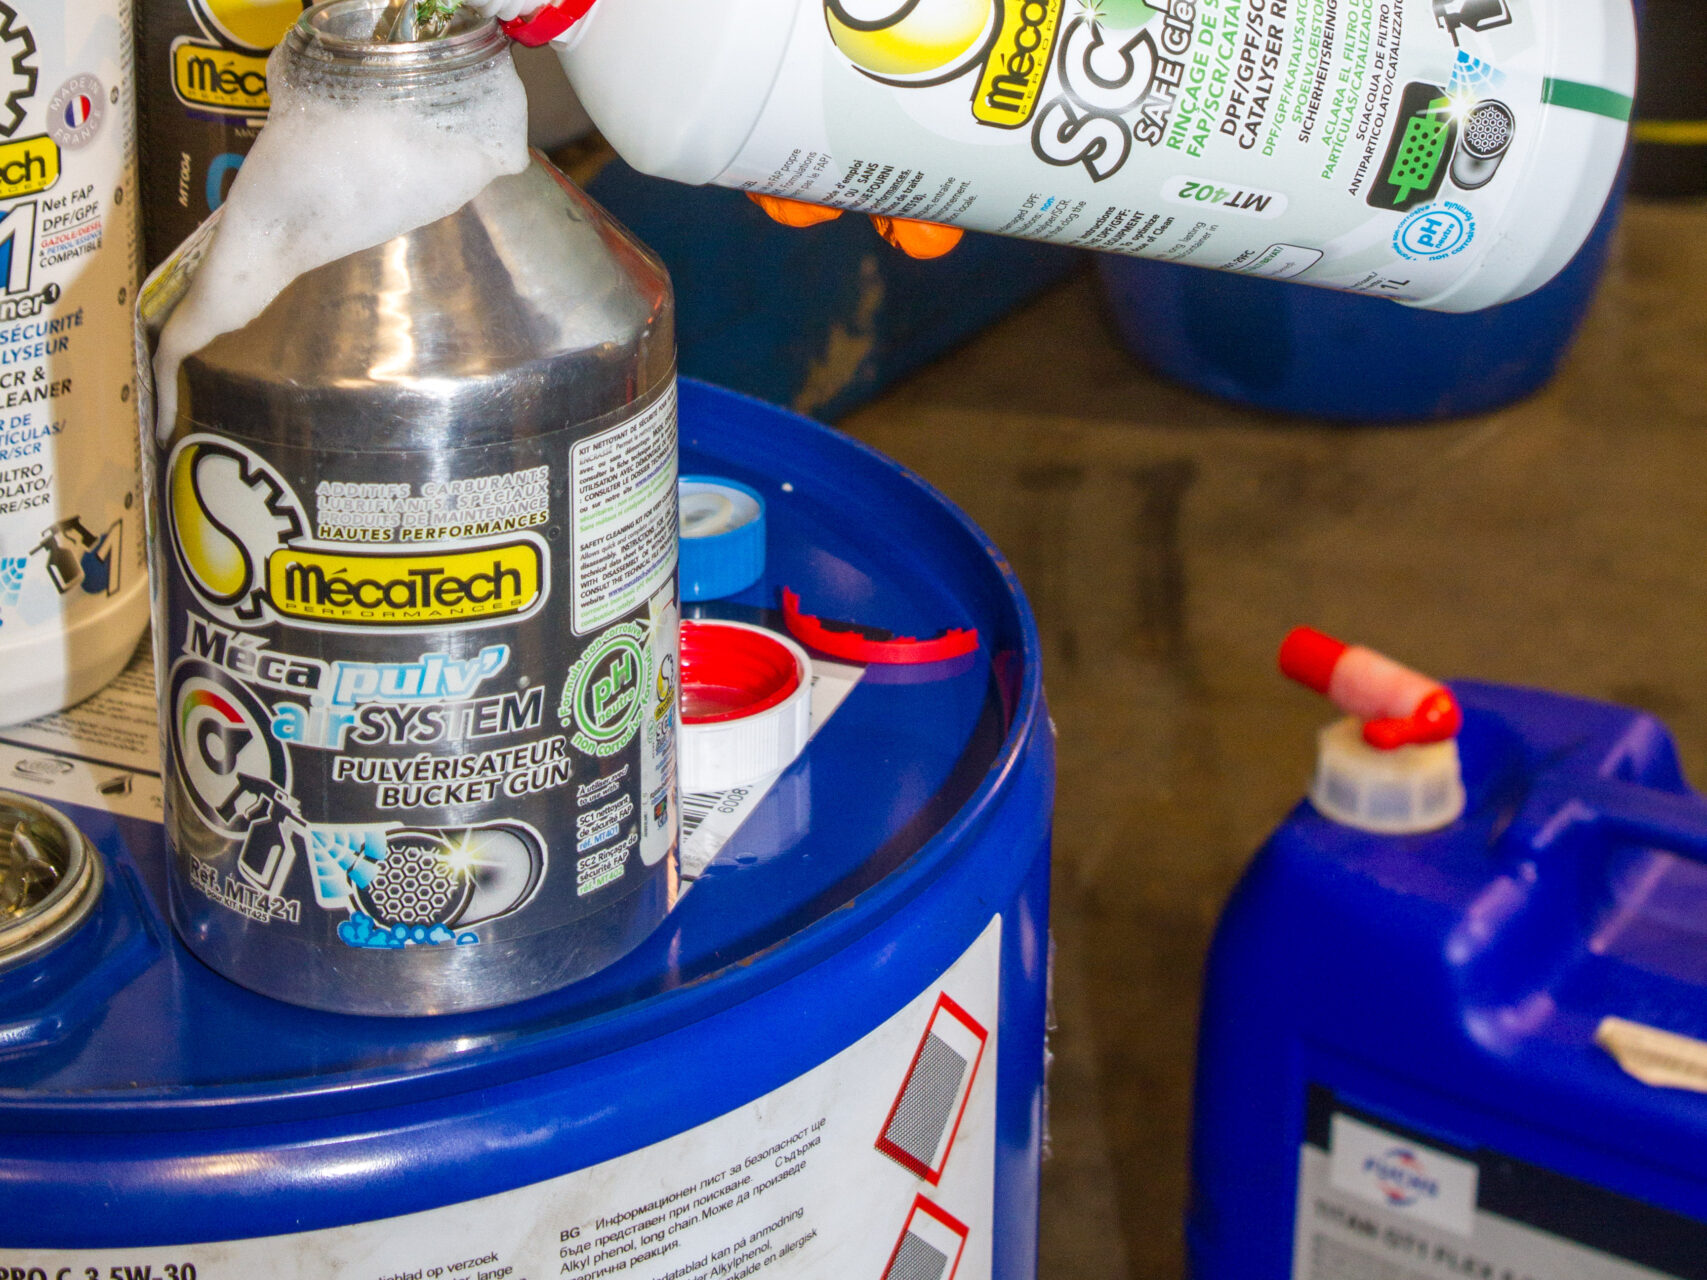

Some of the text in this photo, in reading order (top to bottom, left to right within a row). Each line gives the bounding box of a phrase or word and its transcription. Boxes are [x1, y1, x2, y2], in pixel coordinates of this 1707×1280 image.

[1343, 10, 1360, 61] FILTRO
[1166, 51, 1210, 150] RINÇAGE
[1198, 13, 1218, 47] DE
[1238, 24, 1284, 150] CATALYSER
[1338, 66, 1351, 83] EL
[1356, 3, 1390, 141] SCIACQUA DE FILTRO
[51, 76, 86, 111] MADE
[88, 78, 99, 96] IN
[1134, 56, 1186, 147] SAFE
[1321, 86, 1346, 147] ACLARA
[179, 151, 191, 208] MT004
[857, 162, 879, 184] SANS
[42, 197, 68, 213] Net
[70, 184, 94, 205] FAP
[1179, 180, 1273, 212] MT402
[42, 201, 100, 232] DPF/GPF
[1417, 217, 1443, 248] pH
[1435, 223, 1455, 249] neutre
[39, 237, 103, 269] COMPATIBLE
[33, 366, 45, 381] &
[10, 413, 31, 428] DE
[318, 467, 548, 498] ADDITIFS CARBURANTS
[319, 483, 548, 512] LUBRIFIANTS SPÉCIAUX
[579, 473, 618, 494] UTILISATION
[584, 481, 621, 501] CONSULTER
[319, 498, 547, 526] PRODUITS DE MAINTENANCE
[320, 511, 548, 540] HAUTES PERFORMANCES
[96, 519, 123, 596] 1
[580, 536, 604, 552] SAFETY
[285, 560, 521, 610] MécaTech
[286, 598, 522, 618] PERFORMANCES
[560, 661, 584, 716] Formule
[593, 650, 632, 714] pH
[597, 689, 636, 726] neutre
[572, 708, 644, 756] non corrosive
[337, 737, 567, 781] PULVÉRISATEUR
[381, 761, 571, 807] BUCKET GUN
[580, 796, 629, 826] SC1 nettoyant
[580, 805, 633, 838] de sécurité FAP
[580, 857, 596, 870] SC2
[598, 840, 627, 861] Rinçage
[580, 852, 629, 882] sécurité FAP
[191, 855, 299, 922] Réf. MT421
[560, 1116, 827, 1243] BG Информационен лист за безопасност ще
[559, 1135, 822, 1259] бъде представен при поискване. Съдържа
[559, 1255, 591, 1276] Alkyl
[594, 1241, 638, 1268] phenol,
[640, 1229, 666, 1250] long
[736, 1191, 751, 1206] да
[752, 1159, 807, 1196] произведе
[711, 1206, 804, 1263] kan på anmodning
[763, 1227, 818, 1266] en allergisk
[427, 1251, 499, 1279] op verzoek
[630, 1239, 682, 1269] реакция.
[709, 1242, 773, 1279] Alkylphenol,
[477, 1265, 513, 1280] lange
